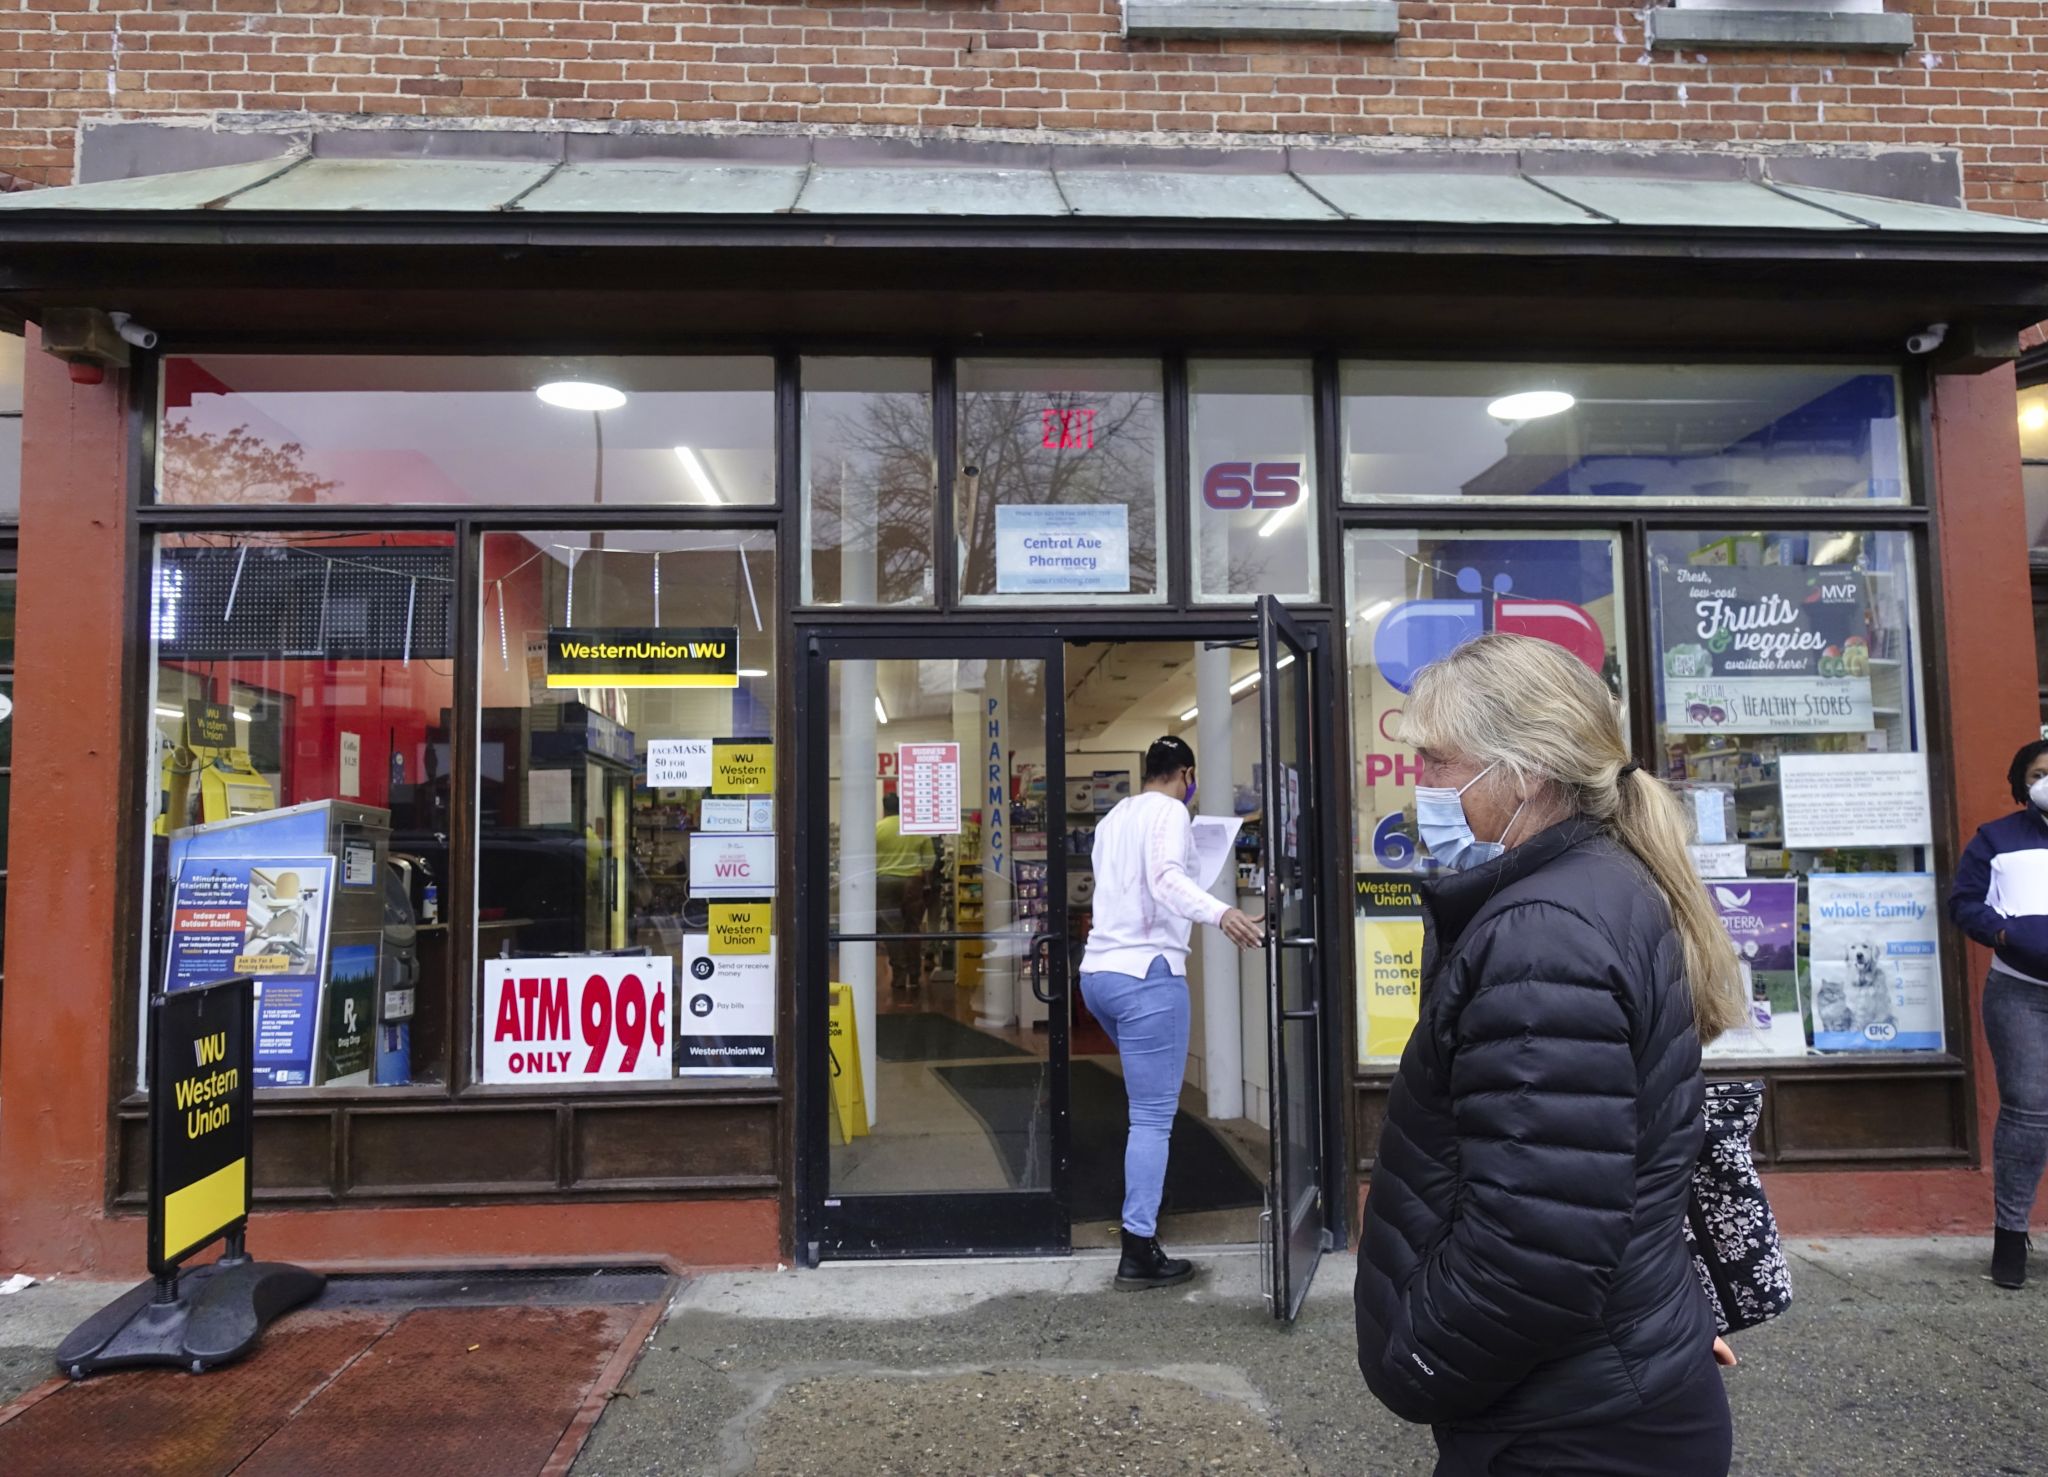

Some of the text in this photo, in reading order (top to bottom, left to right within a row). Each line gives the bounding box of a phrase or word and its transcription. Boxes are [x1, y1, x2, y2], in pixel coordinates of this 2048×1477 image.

[1042, 408, 1096, 448] EXIT
[1203, 462, 1300, 510] 65
[1024, 537, 1102, 549] Central Ave
[1029, 555, 1097, 569] Pharmacy
[1677, 568, 1712, 584] Fresh,
[1689, 586, 1737, 598] low-cost
[1822, 584, 1857, 598] MVP
[1696, 593, 1799, 639] Fruits
[1734, 627, 1827, 659] veggies
[560, 642, 688, 659] WesternUnion
[1725, 658, 1808, 670] available here!
[197, 717, 228, 732] Wstern
[655, 758, 666, 767] 50
[735, 753, 754, 763] WU
[719, 765, 766, 775] Western
[727, 774, 759, 784] Union
[987, 698, 1003, 872] PHARMACY
[719, 817, 742, 825] CPESN
[715, 863, 750, 877] WIC
[180, 882, 211, 890] Stairlift
[222, 882, 249, 890] Safety
[1357, 882, 1411, 893] Western
[1374, 894, 1411, 906] Union
[1820, 900, 1926, 920] whole family
[181, 919, 241, 928] Outdoor Stairlifts
[731, 913, 750, 923] WU
[716, 925, 763, 934] Western
[723, 935, 755, 945] Union
[1374, 950, 1413, 965] Send
[718, 962, 735, 970] Send
[1374, 968, 1422, 979] mone
[1375, 982, 1417, 996] here!
[494, 978, 571, 1042] ATM
[1869, 1026, 1890, 1036] EPIC
[197, 1032, 225, 1066] WU
[508, 1051, 572, 1074] ONLY
[175, 1067, 238, 1111] Western
[187, 1101, 230, 1139] Union
